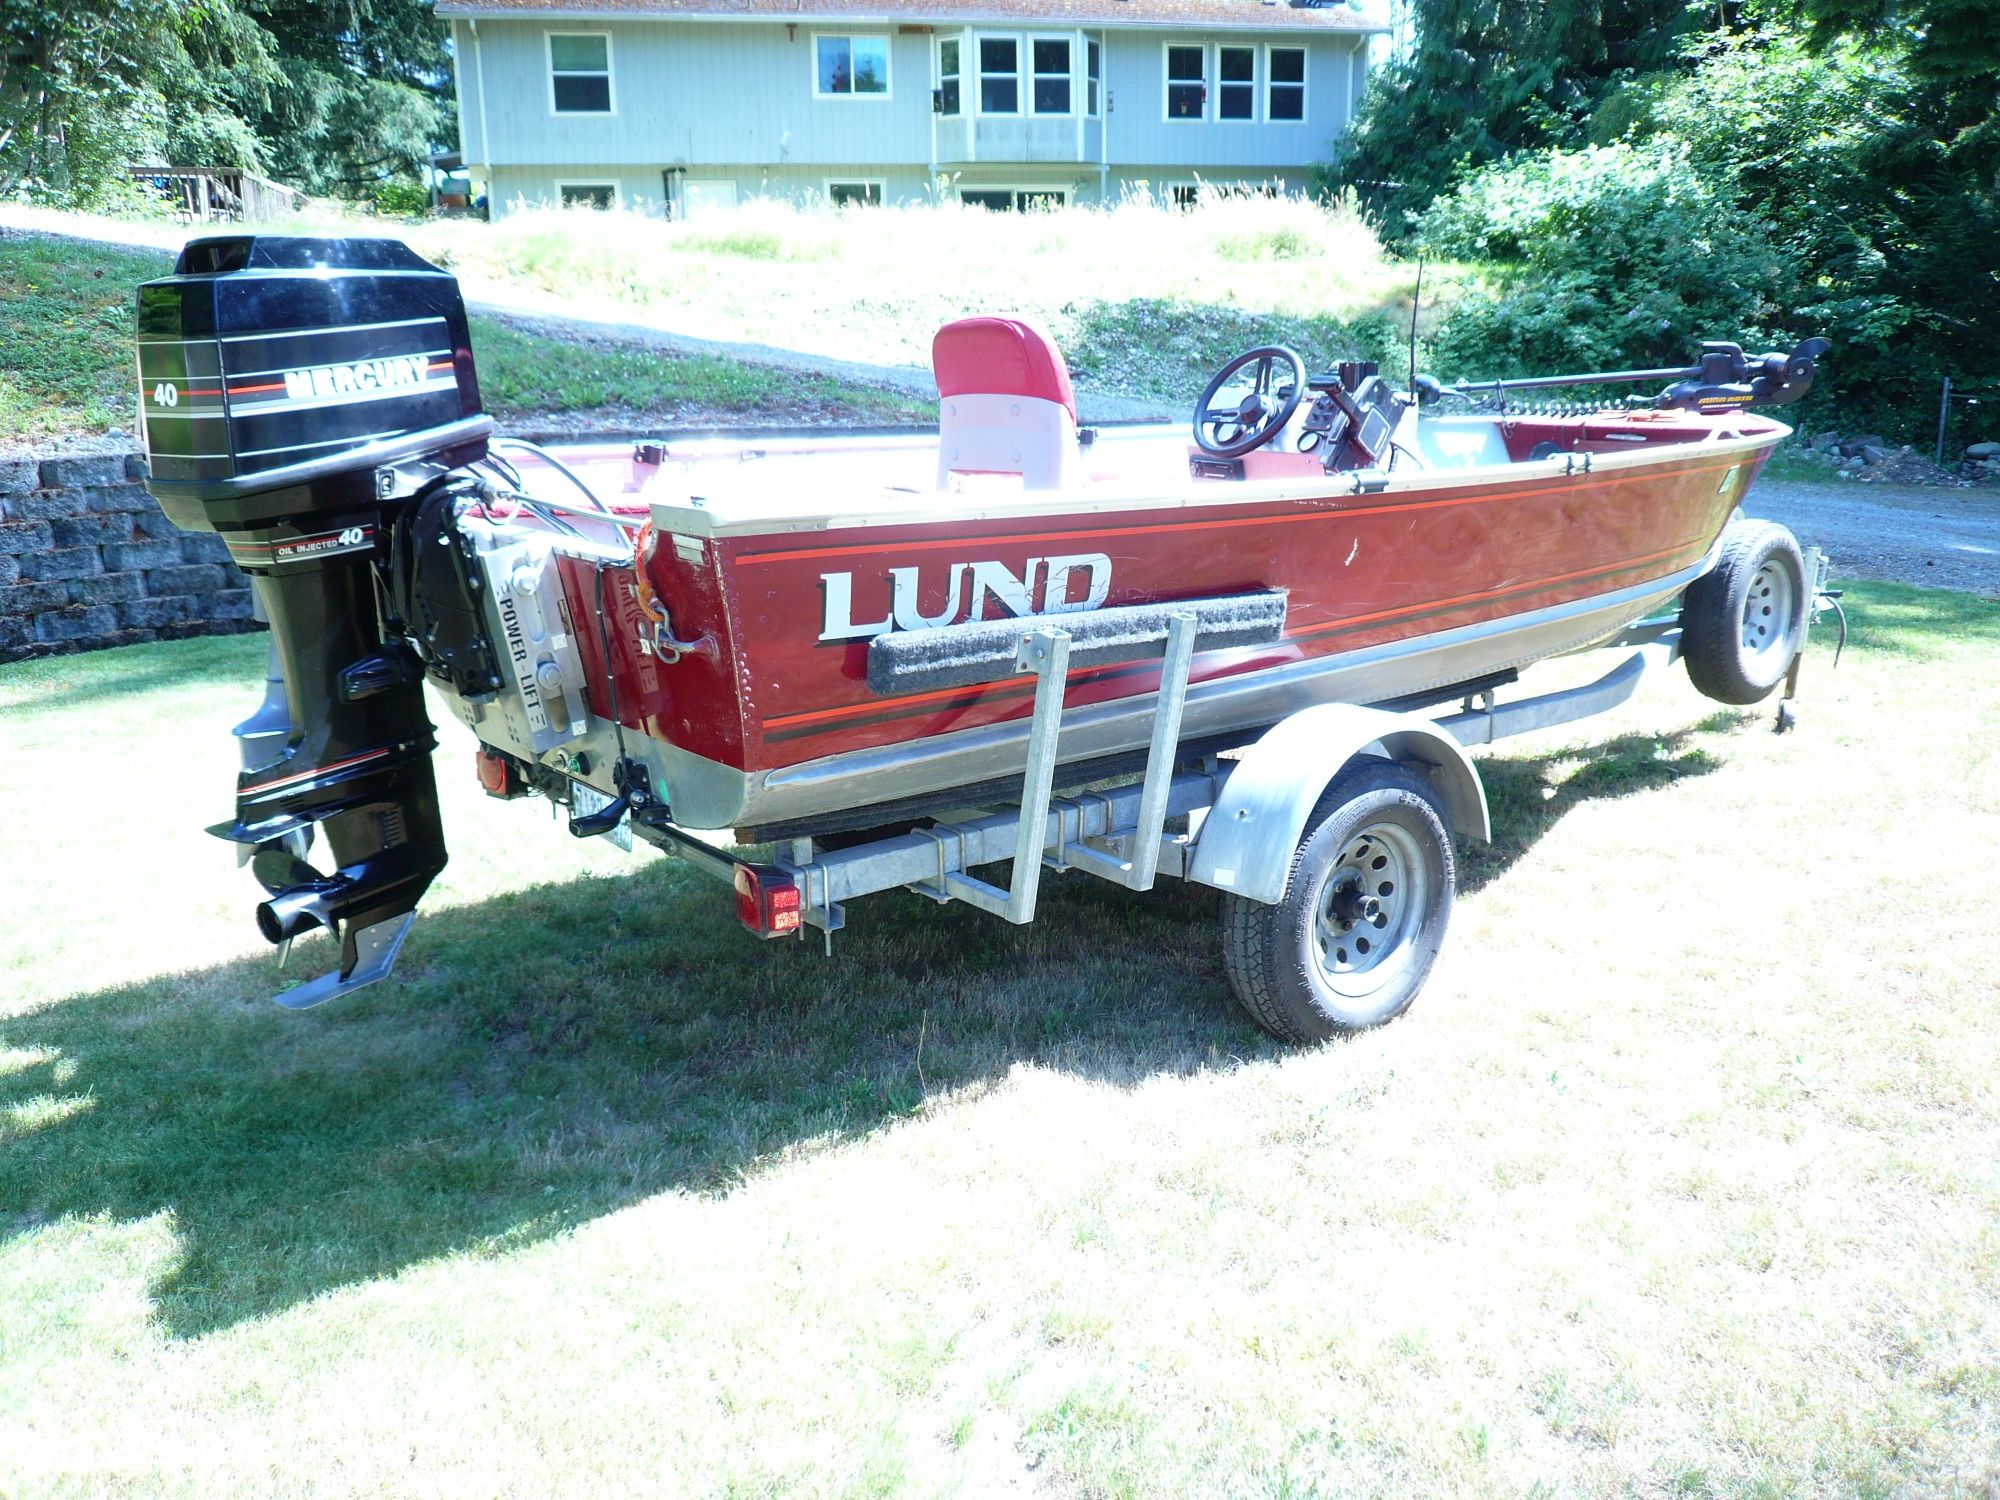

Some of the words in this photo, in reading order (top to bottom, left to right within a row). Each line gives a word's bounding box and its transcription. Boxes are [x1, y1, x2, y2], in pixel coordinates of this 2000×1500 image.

[153, 382, 178, 408] 40
[284, 356, 430, 400] MERCURY
[278, 547, 294, 556] OIL
[296, 539, 338, 553] INJECTED
[338, 527, 363, 546] 40
[816, 553, 1112, 642] LUND
